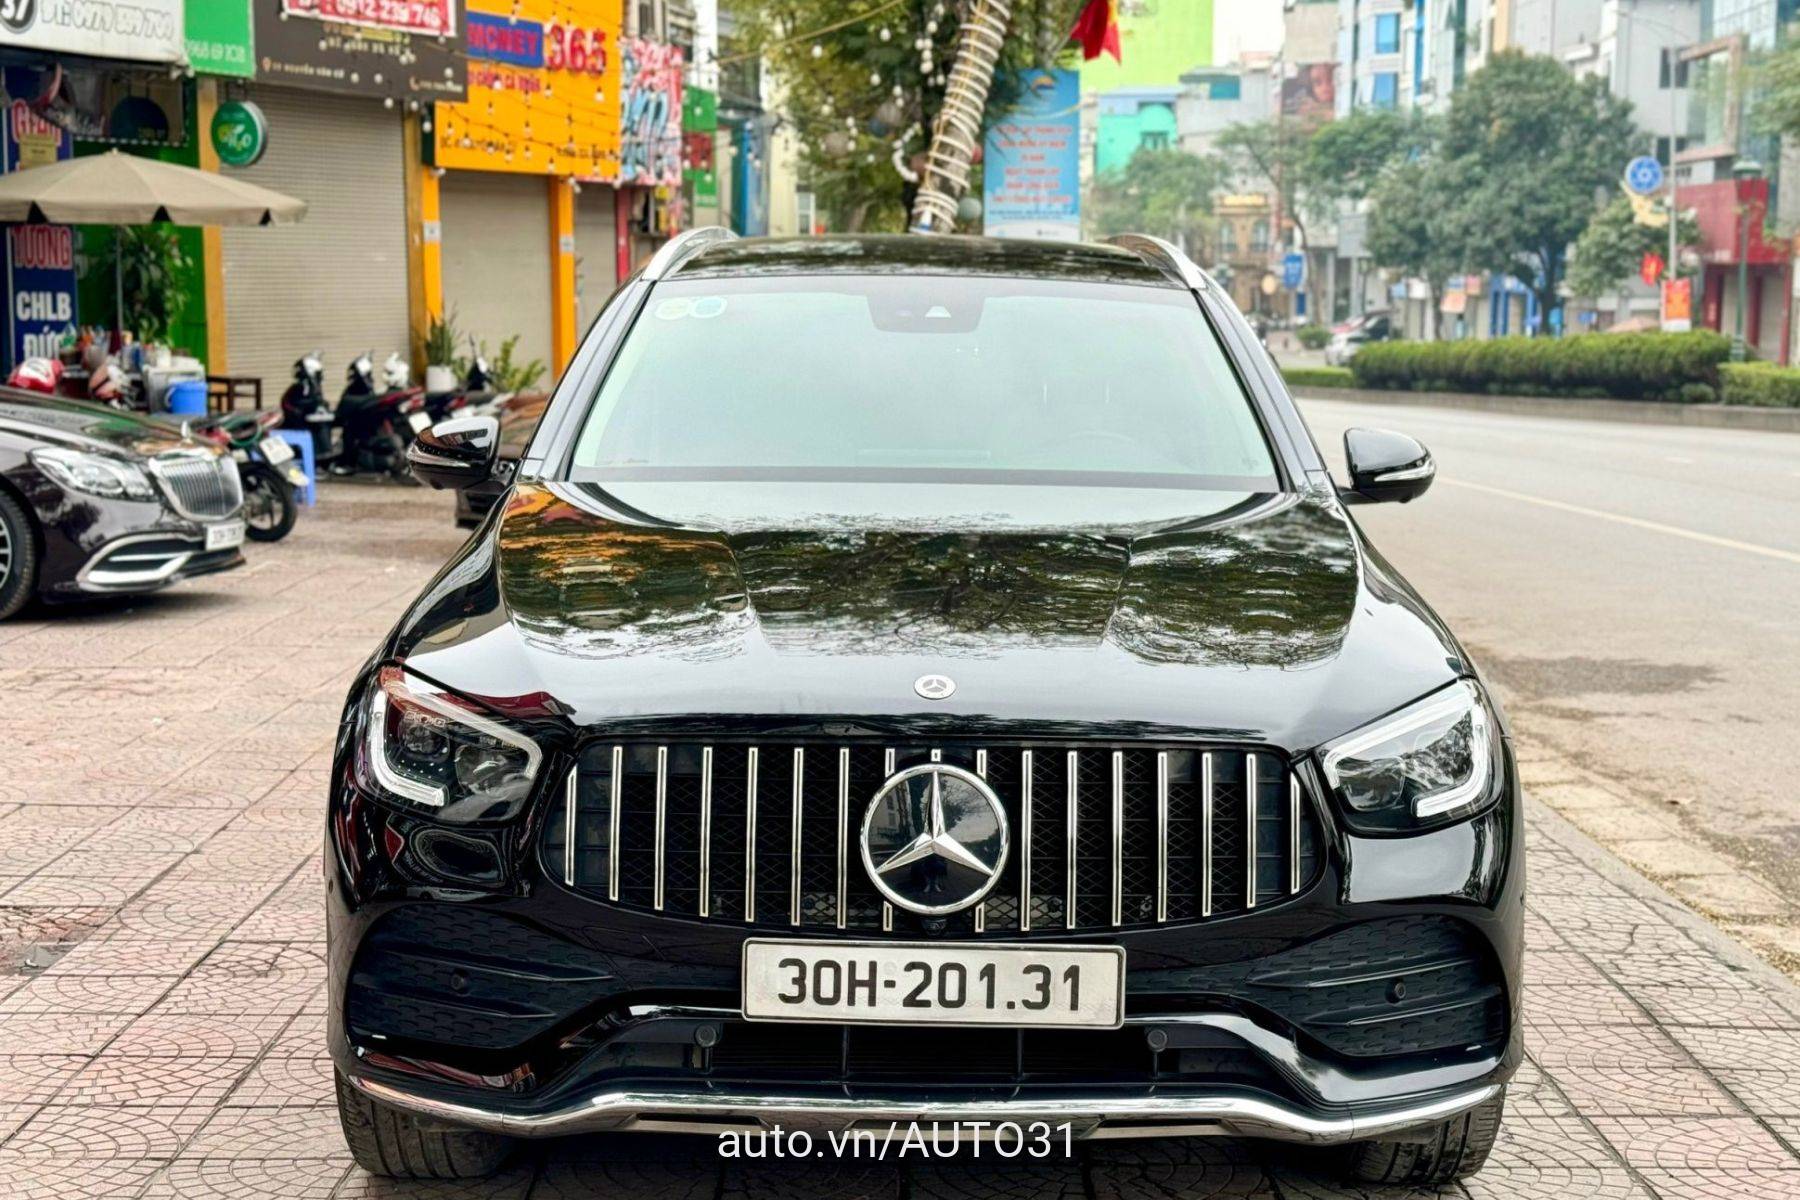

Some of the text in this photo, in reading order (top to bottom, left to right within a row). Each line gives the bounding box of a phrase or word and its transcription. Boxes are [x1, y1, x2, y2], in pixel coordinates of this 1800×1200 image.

[467, 22, 538, 56] MONEY
[546, 24, 607, 76] 365
[16, 290, 72, 321] CHLB
[778, 958, 1081, 1012] 30H-201.31
